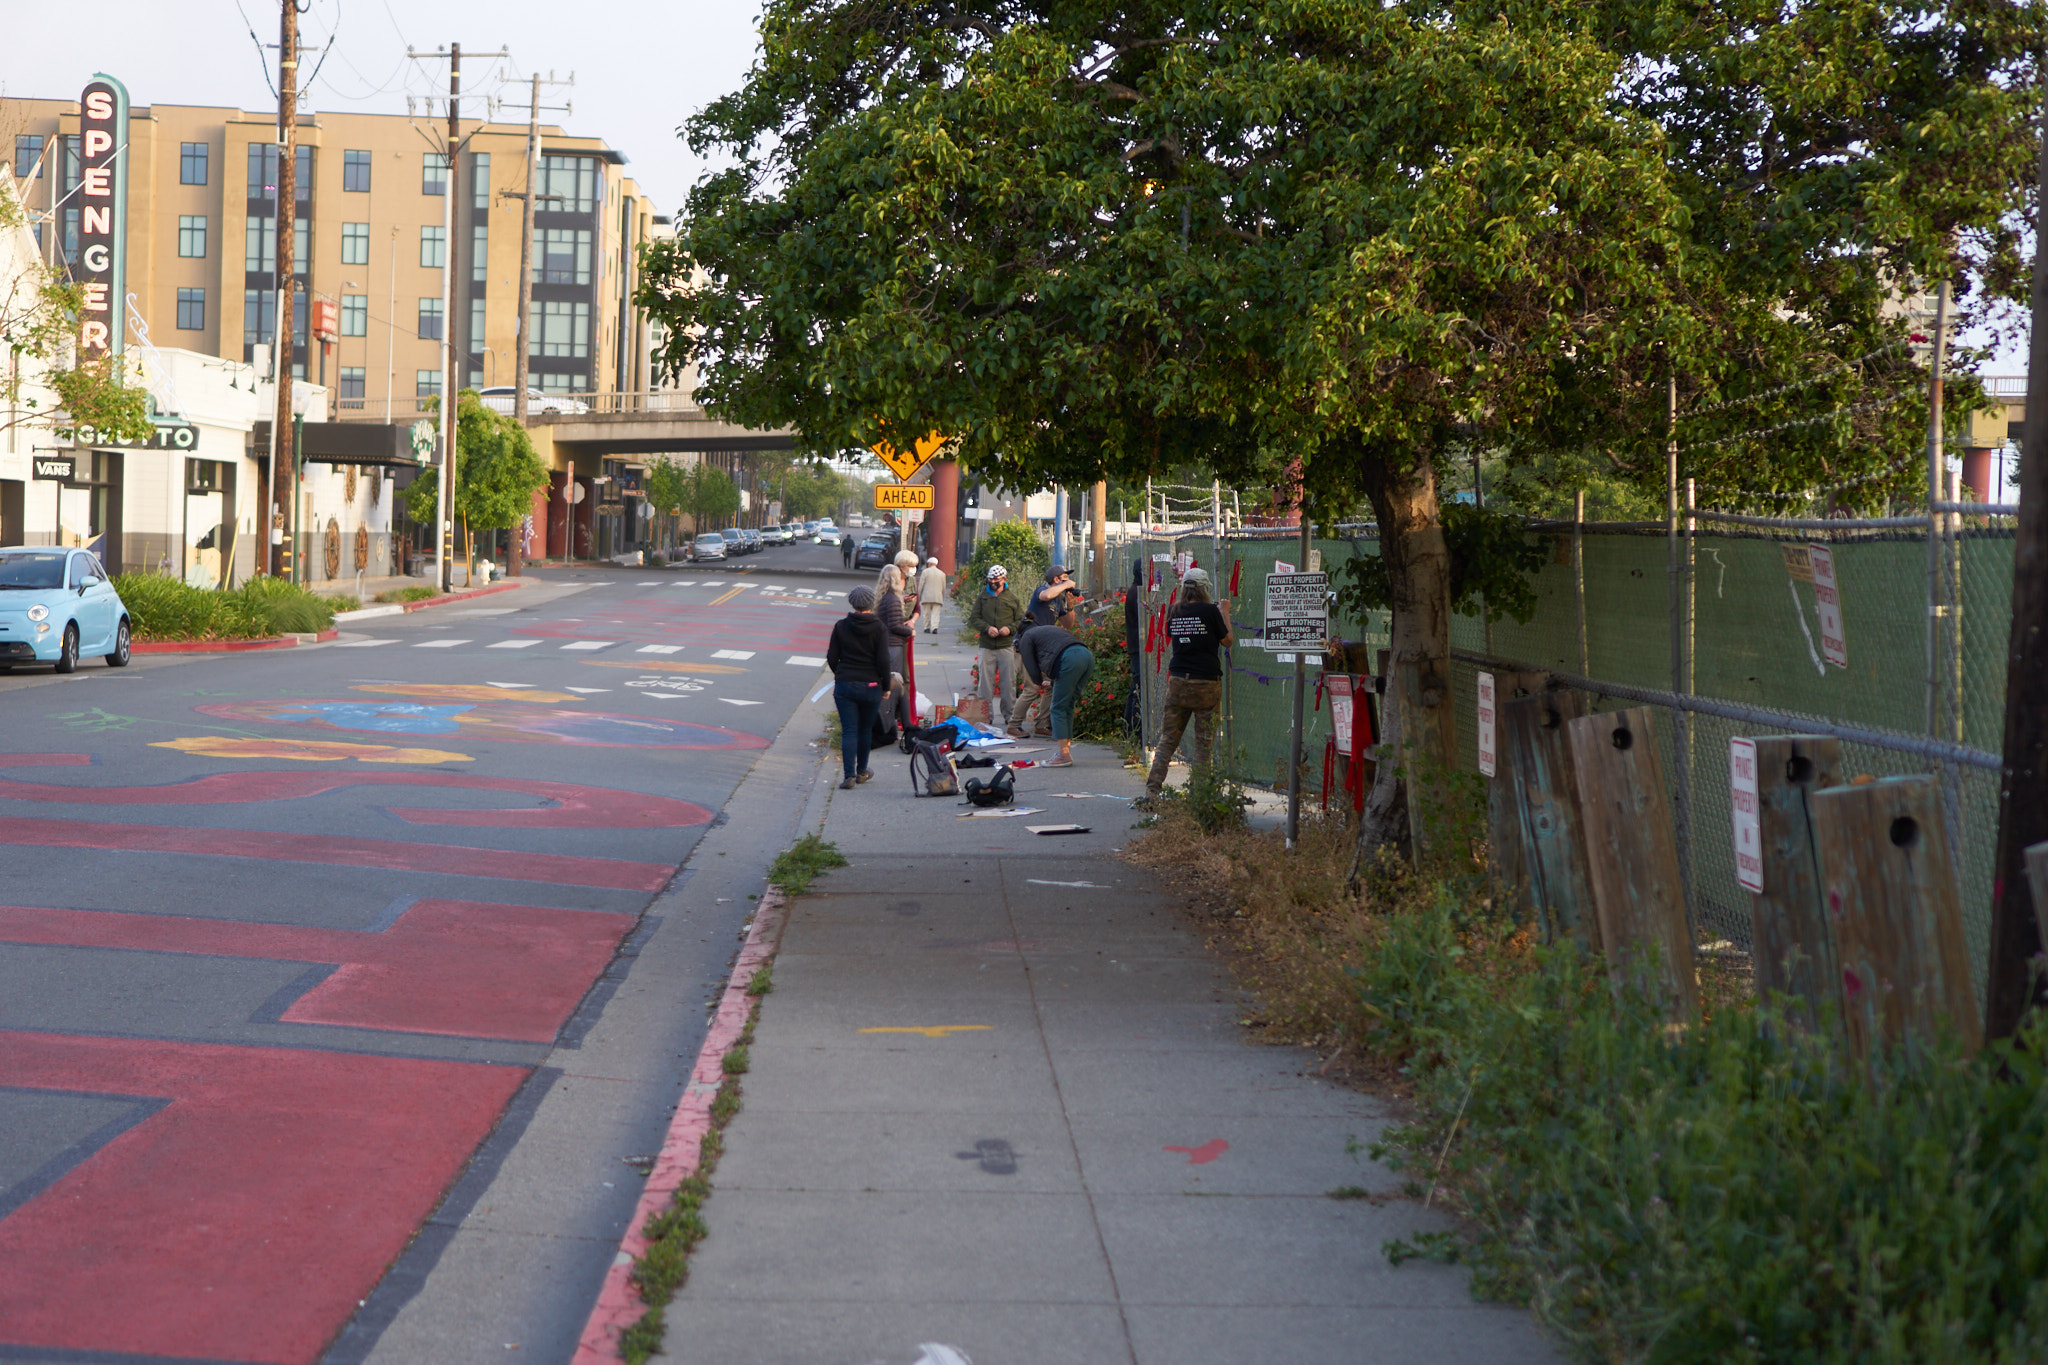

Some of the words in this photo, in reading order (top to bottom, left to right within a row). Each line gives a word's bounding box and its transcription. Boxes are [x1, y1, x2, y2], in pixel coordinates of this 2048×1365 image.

[36, 461, 72, 477] VANS
[882, 490, 926, 504] AHEAD
[1269, 577, 1292, 585] PRIVATE
[1293, 575, 1324, 584] PROPERTY
[1284, 586, 1325, 594] PARKING
[1267, 620, 1289, 628] BERRY
[1289, 619, 1325, 627] BROTHERS
[1735, 755, 1753, 781] PRIVATE
[1733, 788, 1756, 815] PROPERTY
